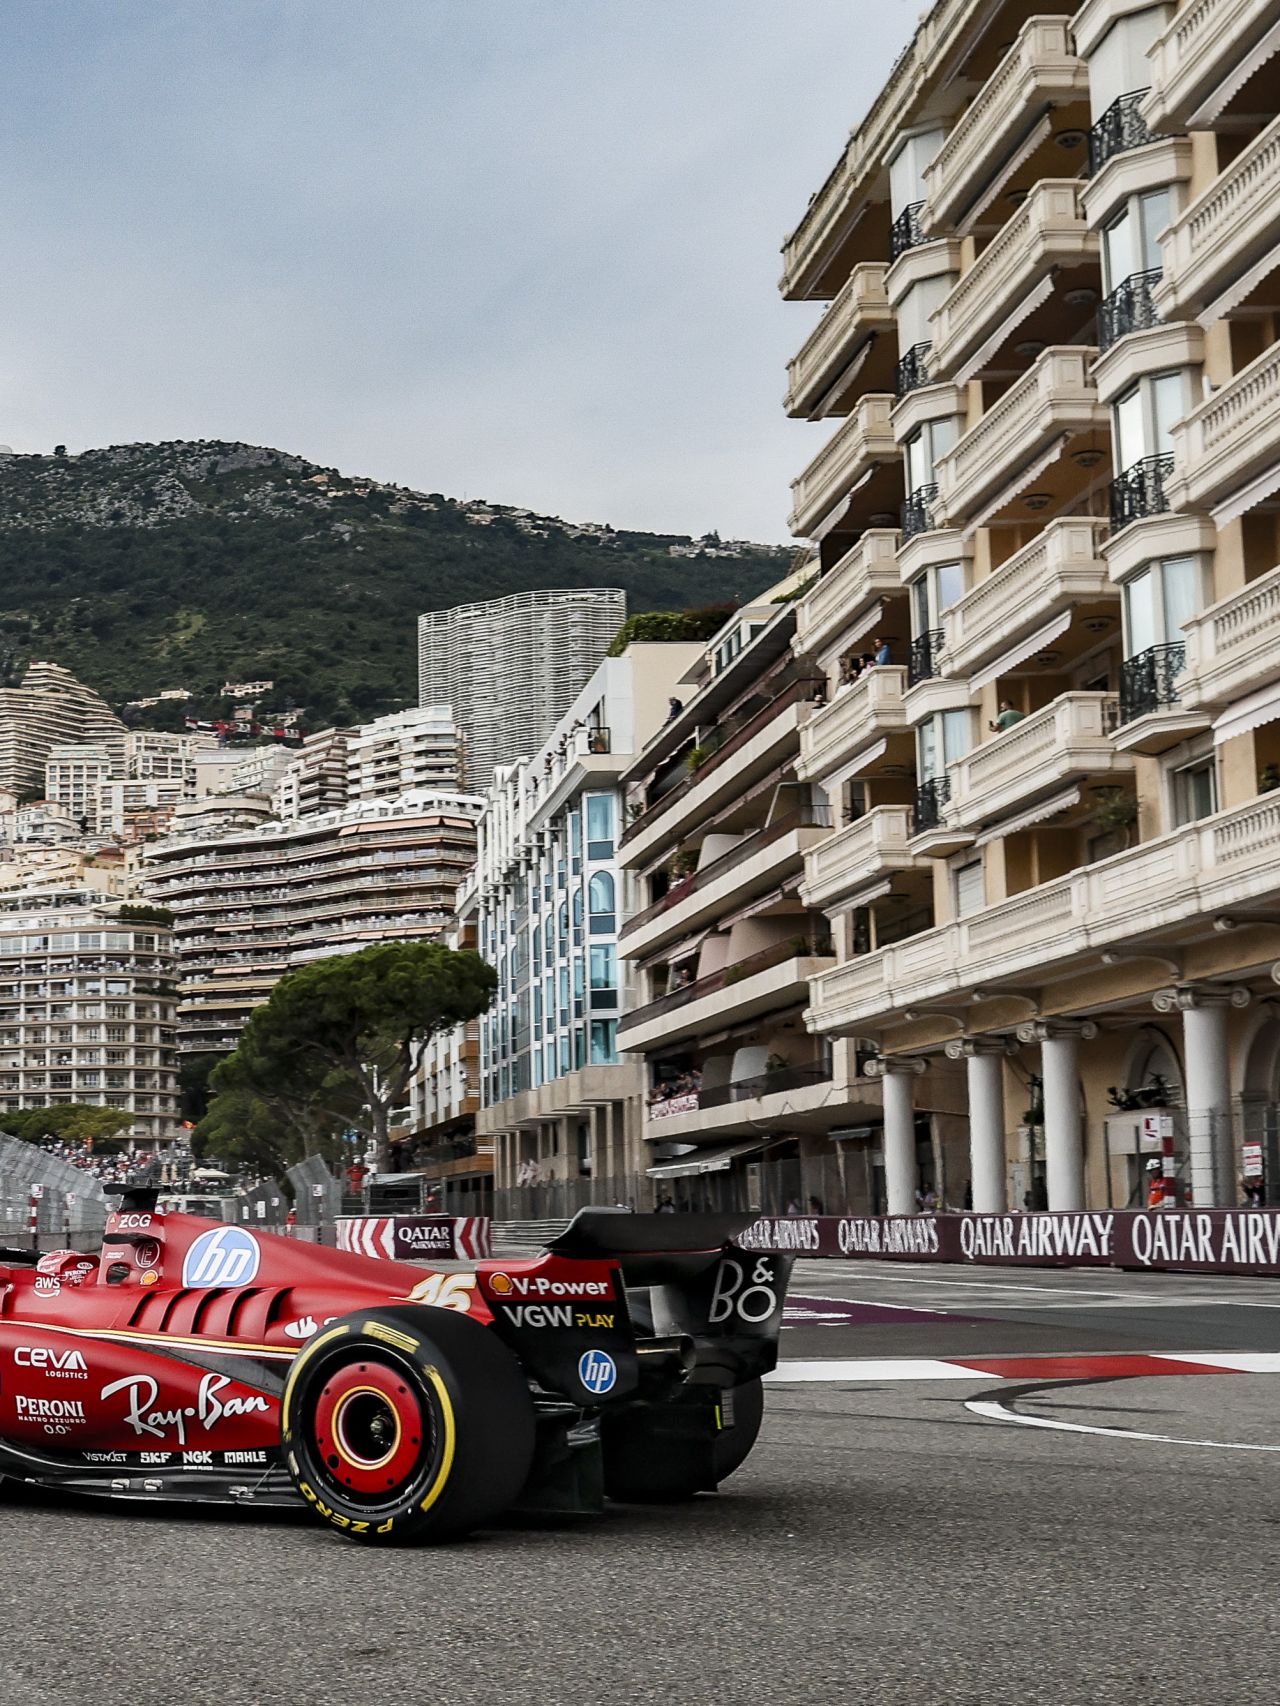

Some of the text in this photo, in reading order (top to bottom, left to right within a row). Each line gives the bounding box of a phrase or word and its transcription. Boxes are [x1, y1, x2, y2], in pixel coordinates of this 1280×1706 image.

[398, 1226, 450, 1243] QATAR
[838, 1219, 880, 1255] QATAR
[960, 1216, 1016, 1259] QATAR
[1132, 1214, 1216, 1266] QATAR
[410, 1240, 451, 1249] AIRWAYS
[187, 1227, 256, 1288] hp
[34, 1276, 61, 1289] aws
[513, 1278, 609, 1296] V-Power
[503, 1305, 615, 1329] VGW PLAY
[45, 1370, 88, 1380] LOGISTICS
[582, 1351, 613, 1393] hp
[15, 1395, 85, 1417] PERONI
[18, 1415, 48, 1423] NASTRO
[140, 1451, 172, 1464] SKF
[182, 1450, 213, 1464] NGK
[223, 1450, 267, 1464] MAHLE
[299, 1481, 371, 1534] ZERO
